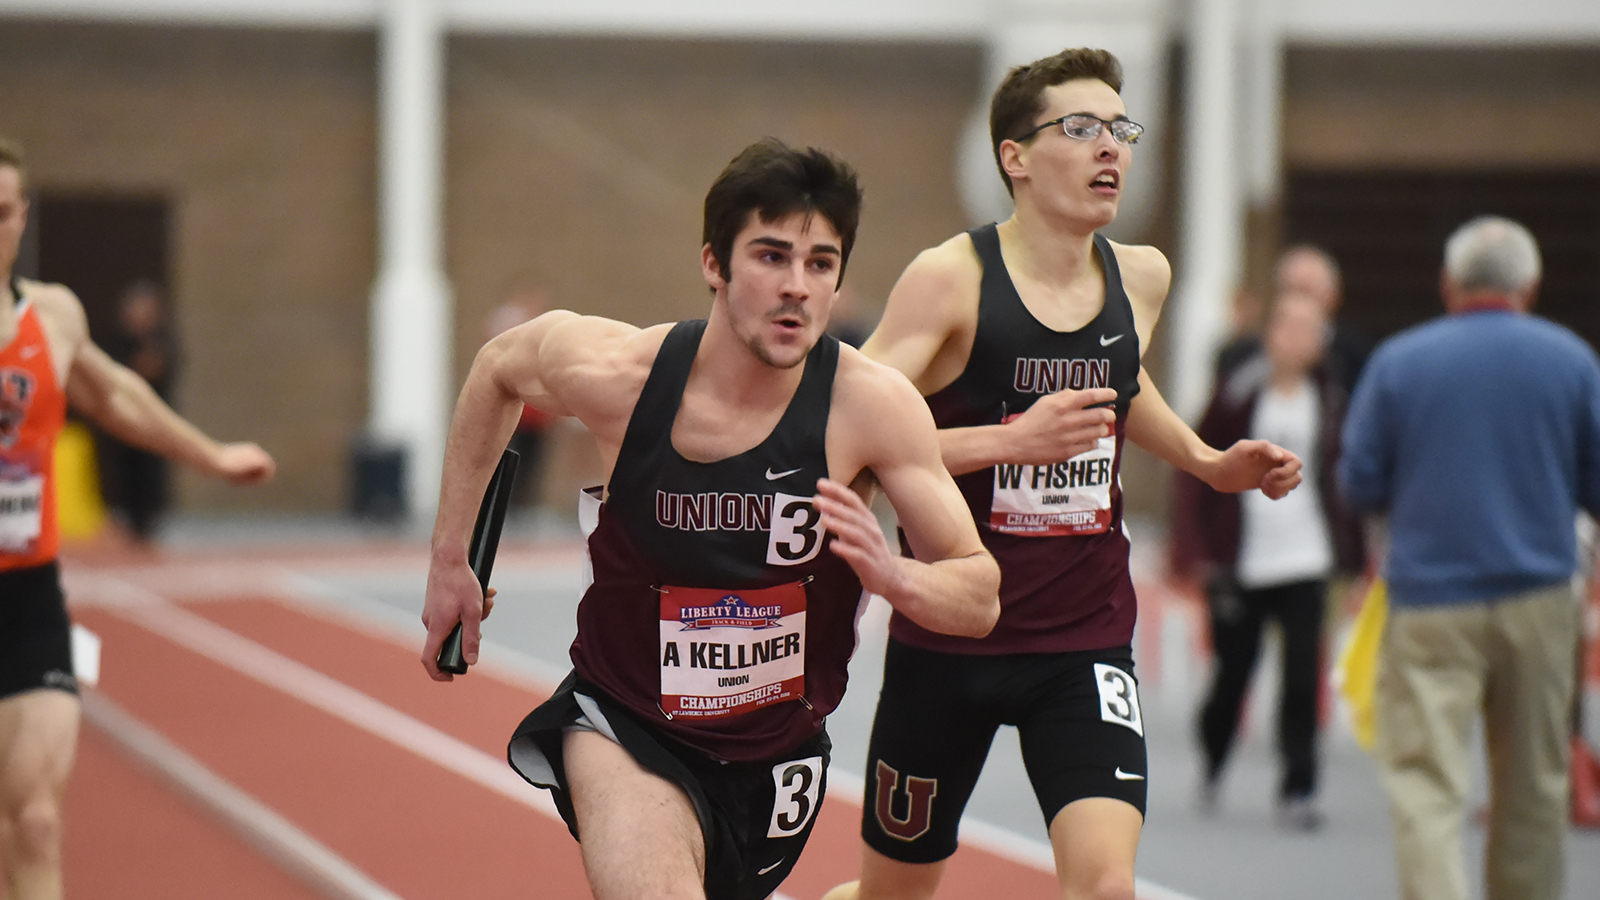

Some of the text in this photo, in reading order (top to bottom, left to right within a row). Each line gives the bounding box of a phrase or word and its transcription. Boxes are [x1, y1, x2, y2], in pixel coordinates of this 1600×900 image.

[1014, 358, 1110, 394] UNION
[998, 457, 1110, 490] W FISHER
[656, 489, 774, 532] UNION
[1042, 494, 1070, 505] UNION
[775, 500, 821, 561] 3
[1006, 510, 1097, 526] CHAMPIONSHIPS
[681, 605, 782, 619] LIBERTY LEAGUE
[663, 632, 800, 669] A KELLNER
[680, 682, 782, 710] CHAMPIONSHIPS
[717, 674, 750, 688] UNION
[1103, 670, 1136, 722] 3
[777, 763, 813, 831] 3
[876, 758, 937, 841] U
